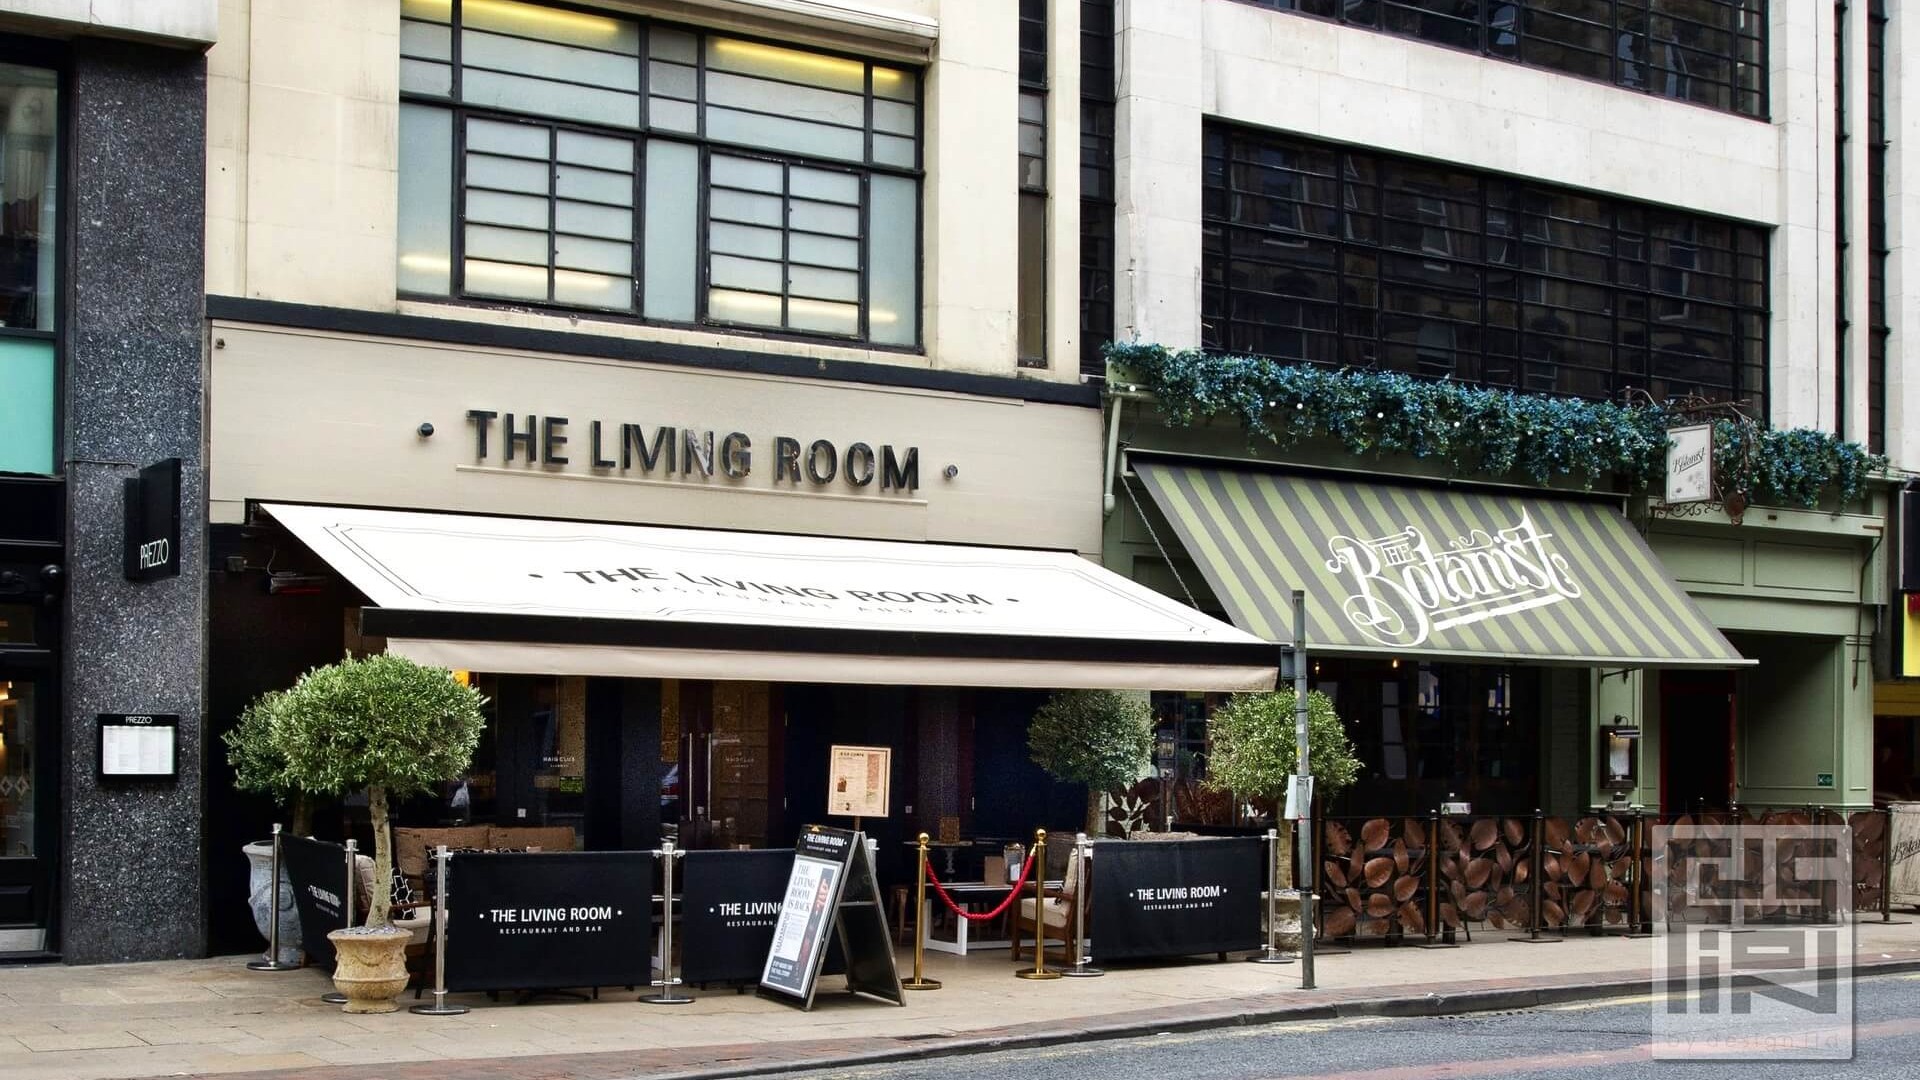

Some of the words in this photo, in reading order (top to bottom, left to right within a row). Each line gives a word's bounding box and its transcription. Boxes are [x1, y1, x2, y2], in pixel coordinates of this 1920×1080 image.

[466, 409, 569, 466] THE
[590, 420, 752, 480] LIVING
[773, 436, 919, 491] ROOM
[140, 538, 169, 570] PREZZO
[1379, 542, 1417, 567] THE
[1325, 505, 1582, 648] Botanist
[563, 567, 670, 585] THE
[674, 571, 840, 601] LIVING
[845, 589, 994, 606] ROOM
[125, 715, 153, 725] PREZZO
[1137, 888, 1155, 901] THE
[1156, 887, 1188, 900] LIVING
[1190, 885, 1220, 899] ROOM
[490, 908, 518, 923] THE
[521, 907, 567, 922] LIVING
[570, 906, 612, 921] ROOM
[719, 903, 742, 916] THE
[500, 927, 558, 935] RESTAURANT
[726, 920, 775, 928] RESTAURAN
